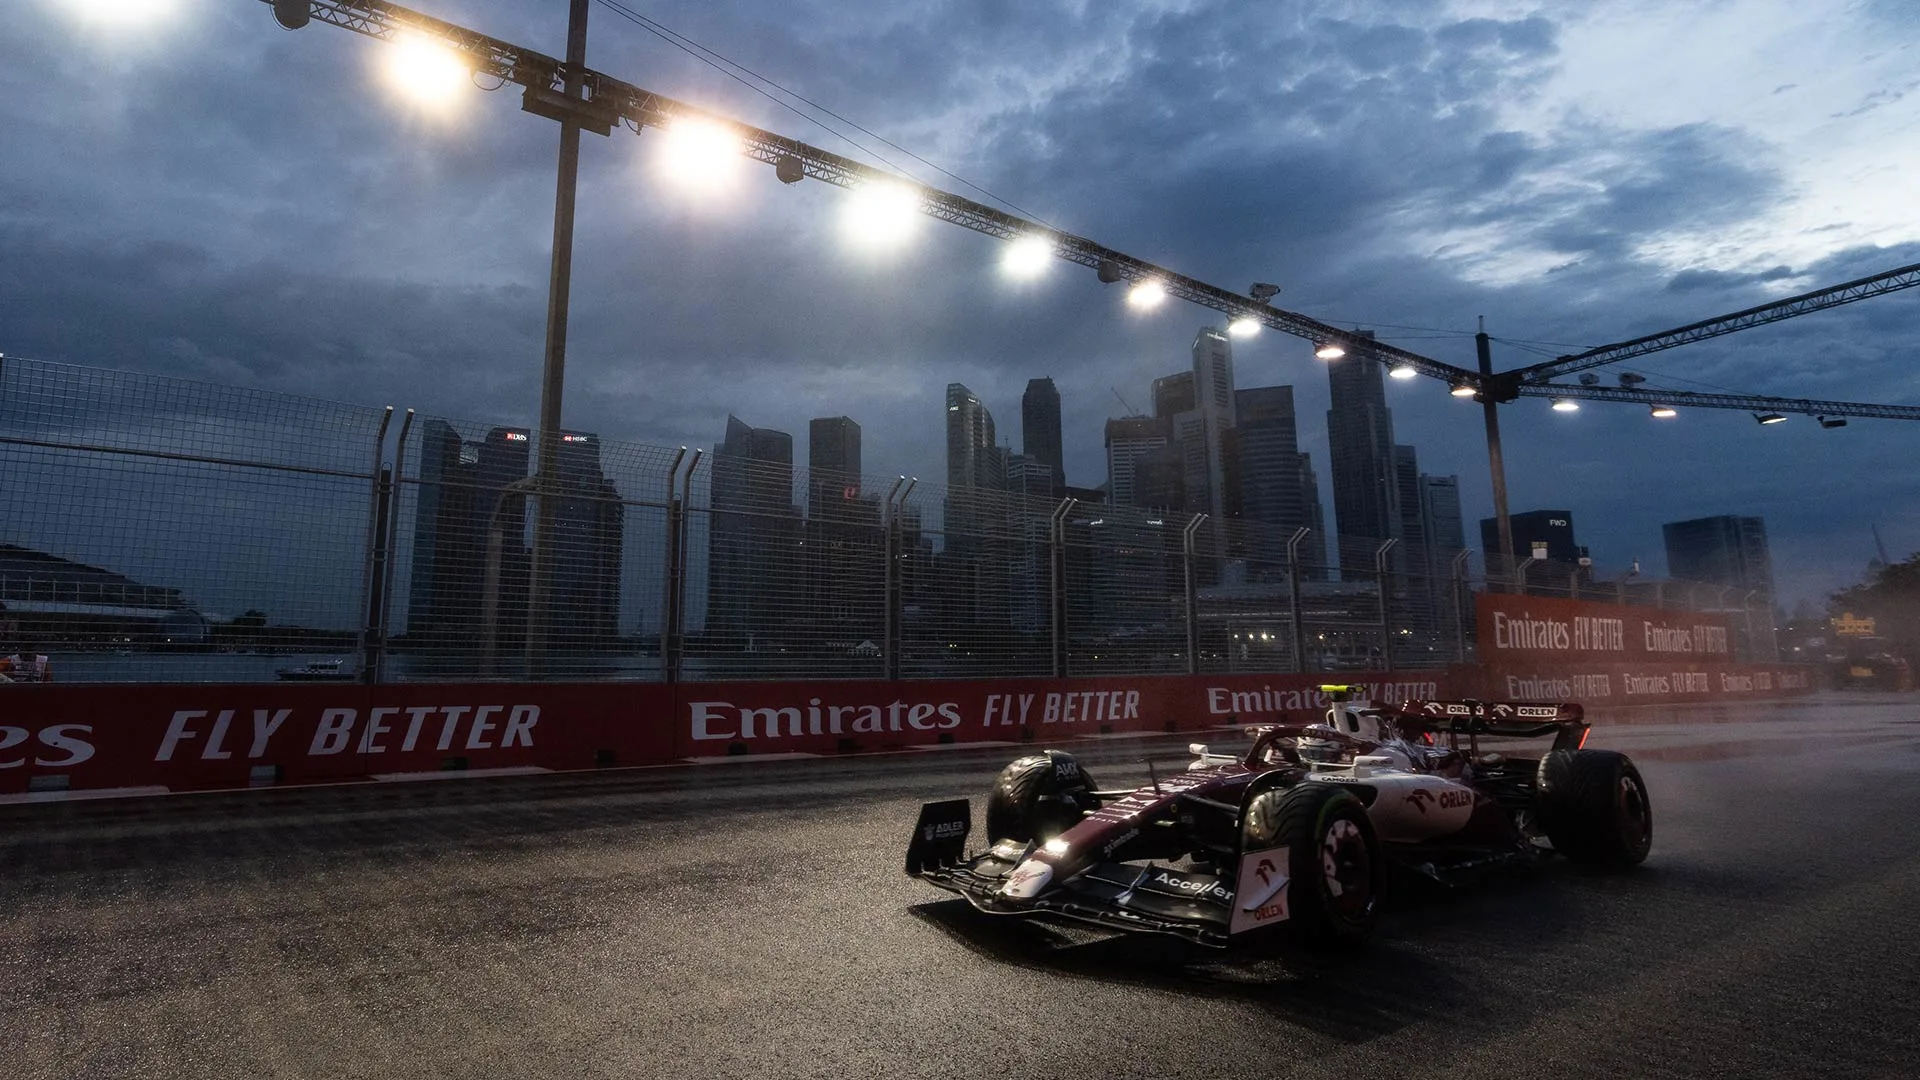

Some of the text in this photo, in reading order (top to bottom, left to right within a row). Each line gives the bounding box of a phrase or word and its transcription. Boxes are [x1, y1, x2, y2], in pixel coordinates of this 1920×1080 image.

[1549, 519, 1567, 527] FWD
[1493, 612, 1624, 652] Emirates FLY BETTER
[1643, 620, 1692, 653] Emirates
[1506, 674, 1572, 700] Emirates
[1623, 673, 1670, 695] Emirates
[1206, 685, 1334, 714] Emirate
[1520, 706, 1555, 716] ORLEN
[688, 690, 1140, 740] Emirates FLY BETTER
[155, 709, 293, 761] FLY
[308, 704, 542, 756] BETTER
[1439, 789, 1472, 809] ORLEN
[935, 820, 964, 833] ADLER
[1253, 903, 1284, 921] ORLEN
